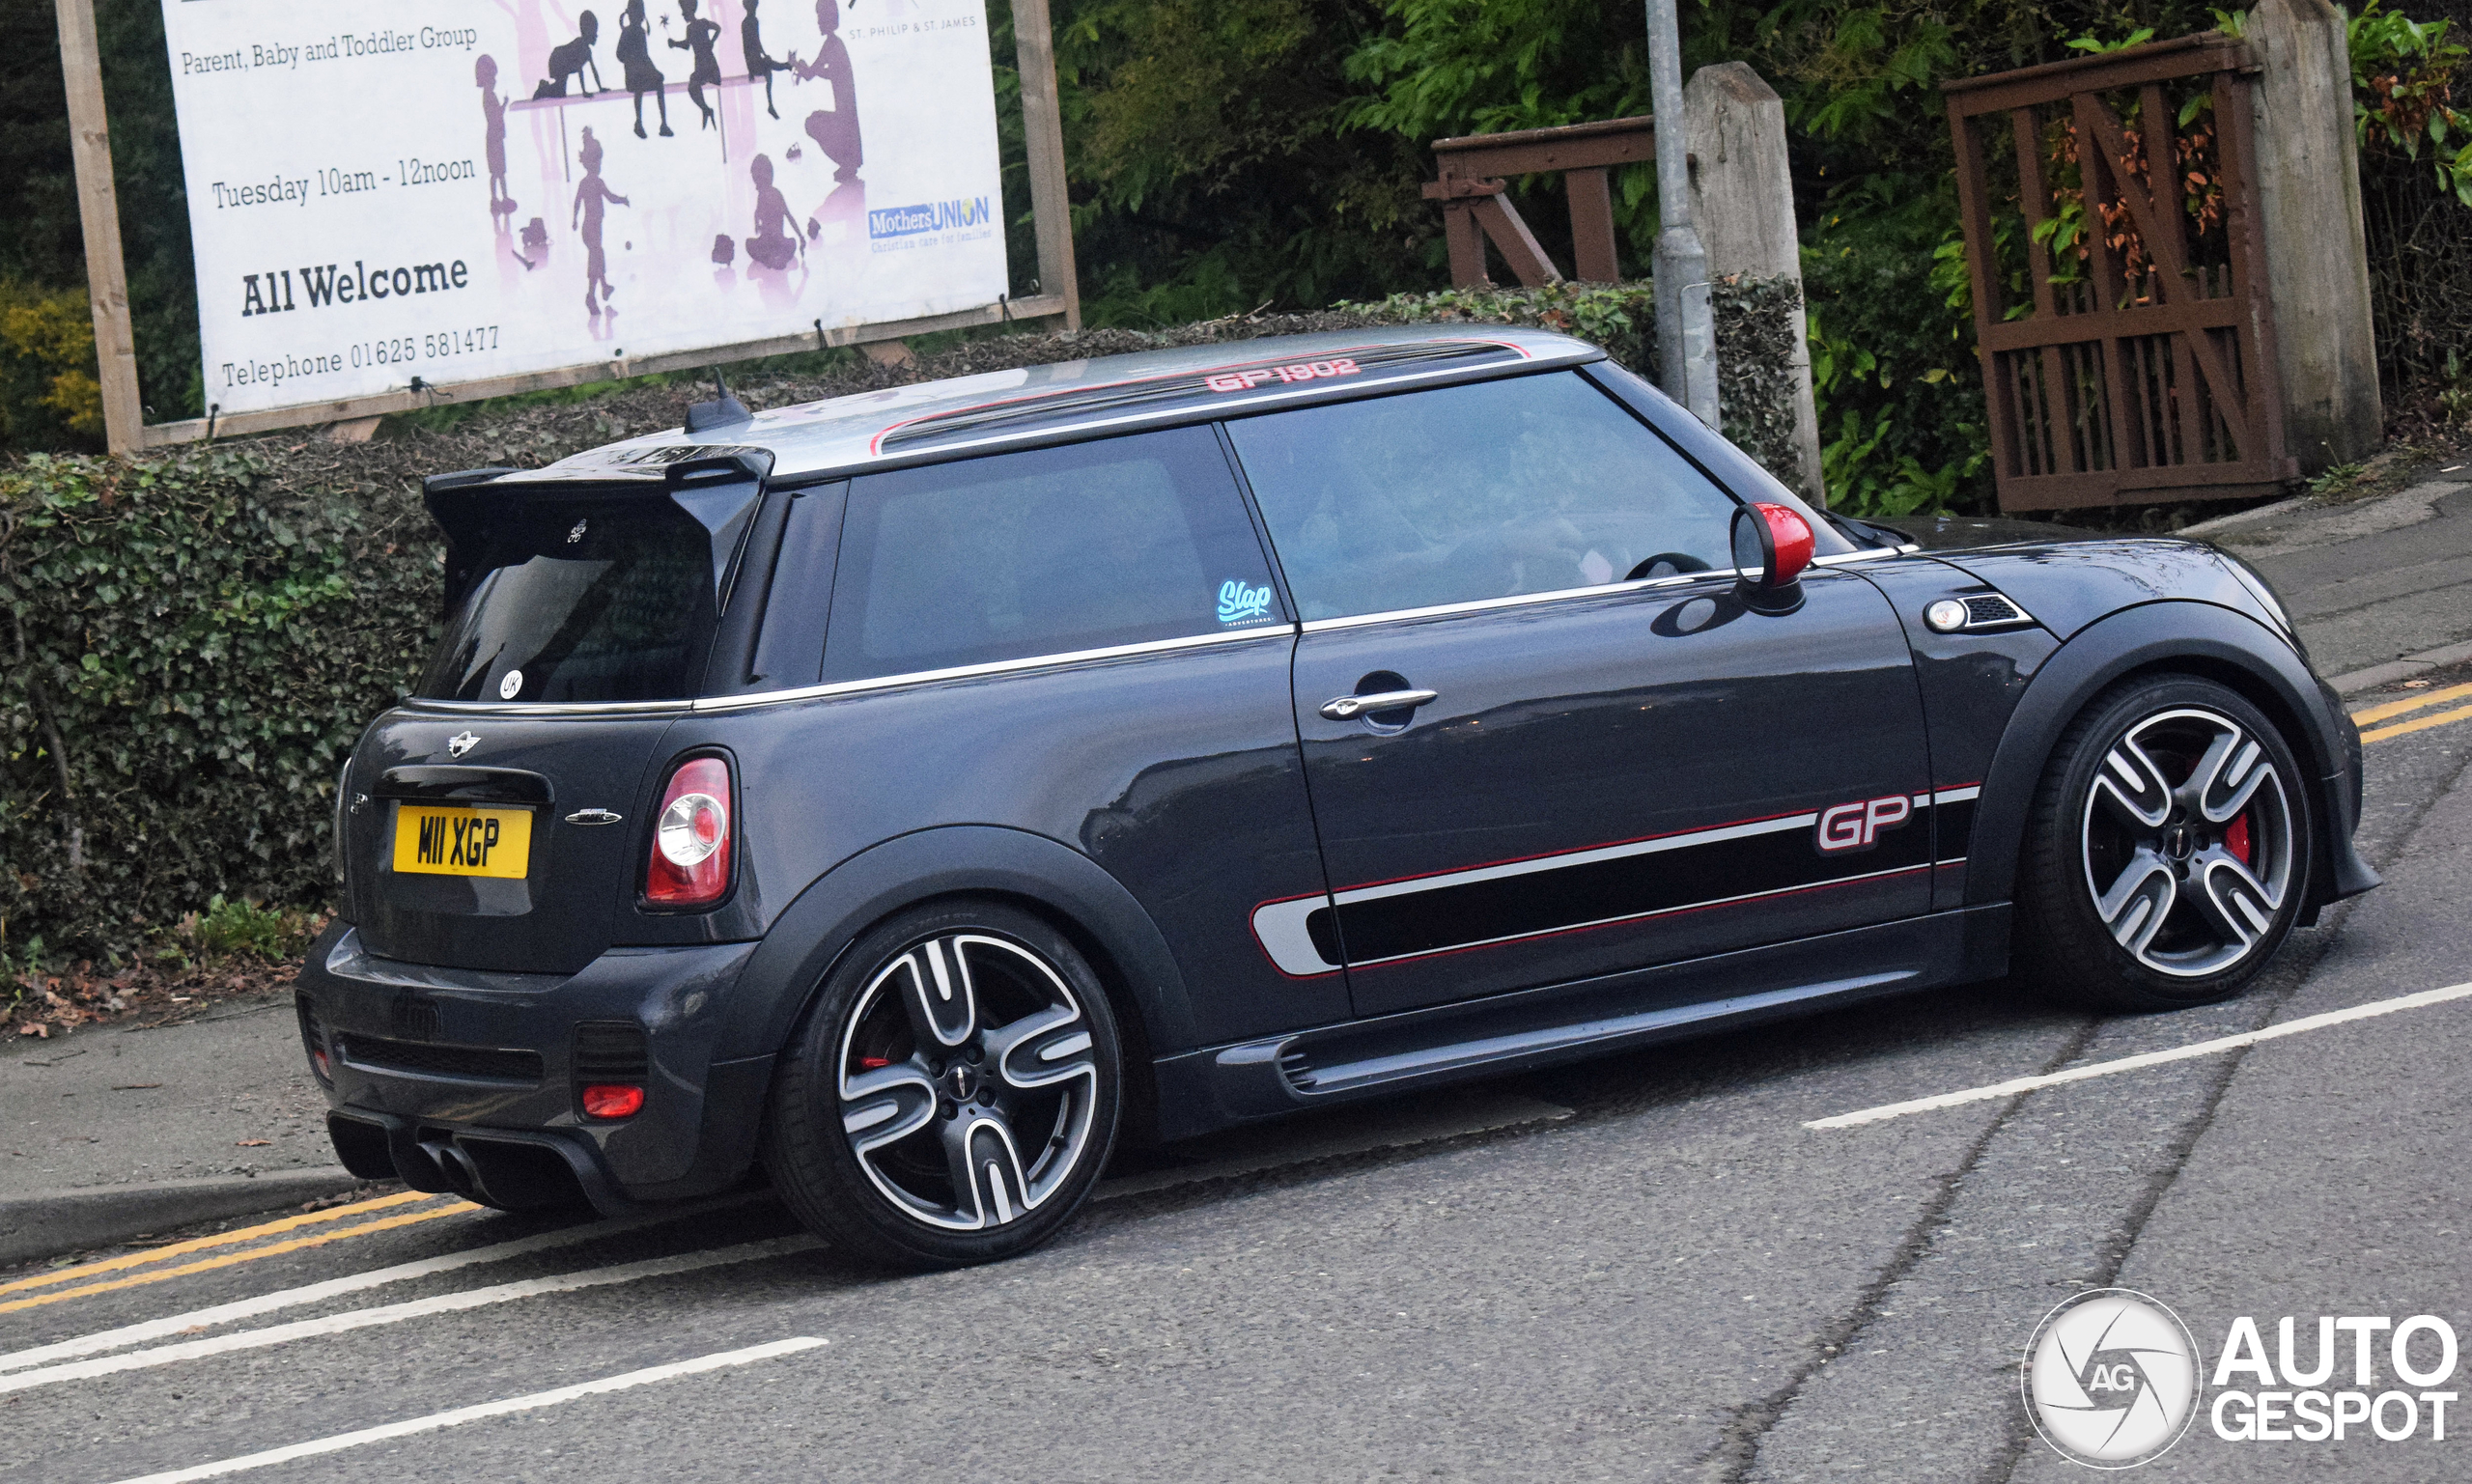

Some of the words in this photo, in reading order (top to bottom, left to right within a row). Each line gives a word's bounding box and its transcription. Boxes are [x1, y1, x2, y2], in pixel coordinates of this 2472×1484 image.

[182, 51, 248, 74] Parent,
[252, 42, 298, 69] Baby
[305, 37, 338, 61] and
[342, 31, 414, 57] Toddler
[420, 26, 477, 50] Group
[849, 29, 865, 40] ST.
[870, 24, 908, 37] PHILIP
[913, 23, 920, 32] &
[924, 20, 938, 31] ST.
[941, 16, 976, 30] JAMES
[212, 176, 309, 209] Tuesday
[319, 168, 377, 196] 10am
[399, 158, 475, 186] 12noon
[871, 238, 915, 253] Christian
[919, 237, 939, 247] care
[941, 234, 954, 244] for
[957, 229, 992, 242] families
[241, 269, 295, 318] All
[299, 259, 468, 308] Welcome
[222, 353, 342, 387] Telephone
[351, 338, 416, 369] 01625
[426, 325, 499, 358] 581477
[1218, 580, 1271, 616] Slap
[504, 677, 520, 692] UK
[450, 817, 499, 866] XGP
[1819, 794, 1909, 851] GP
